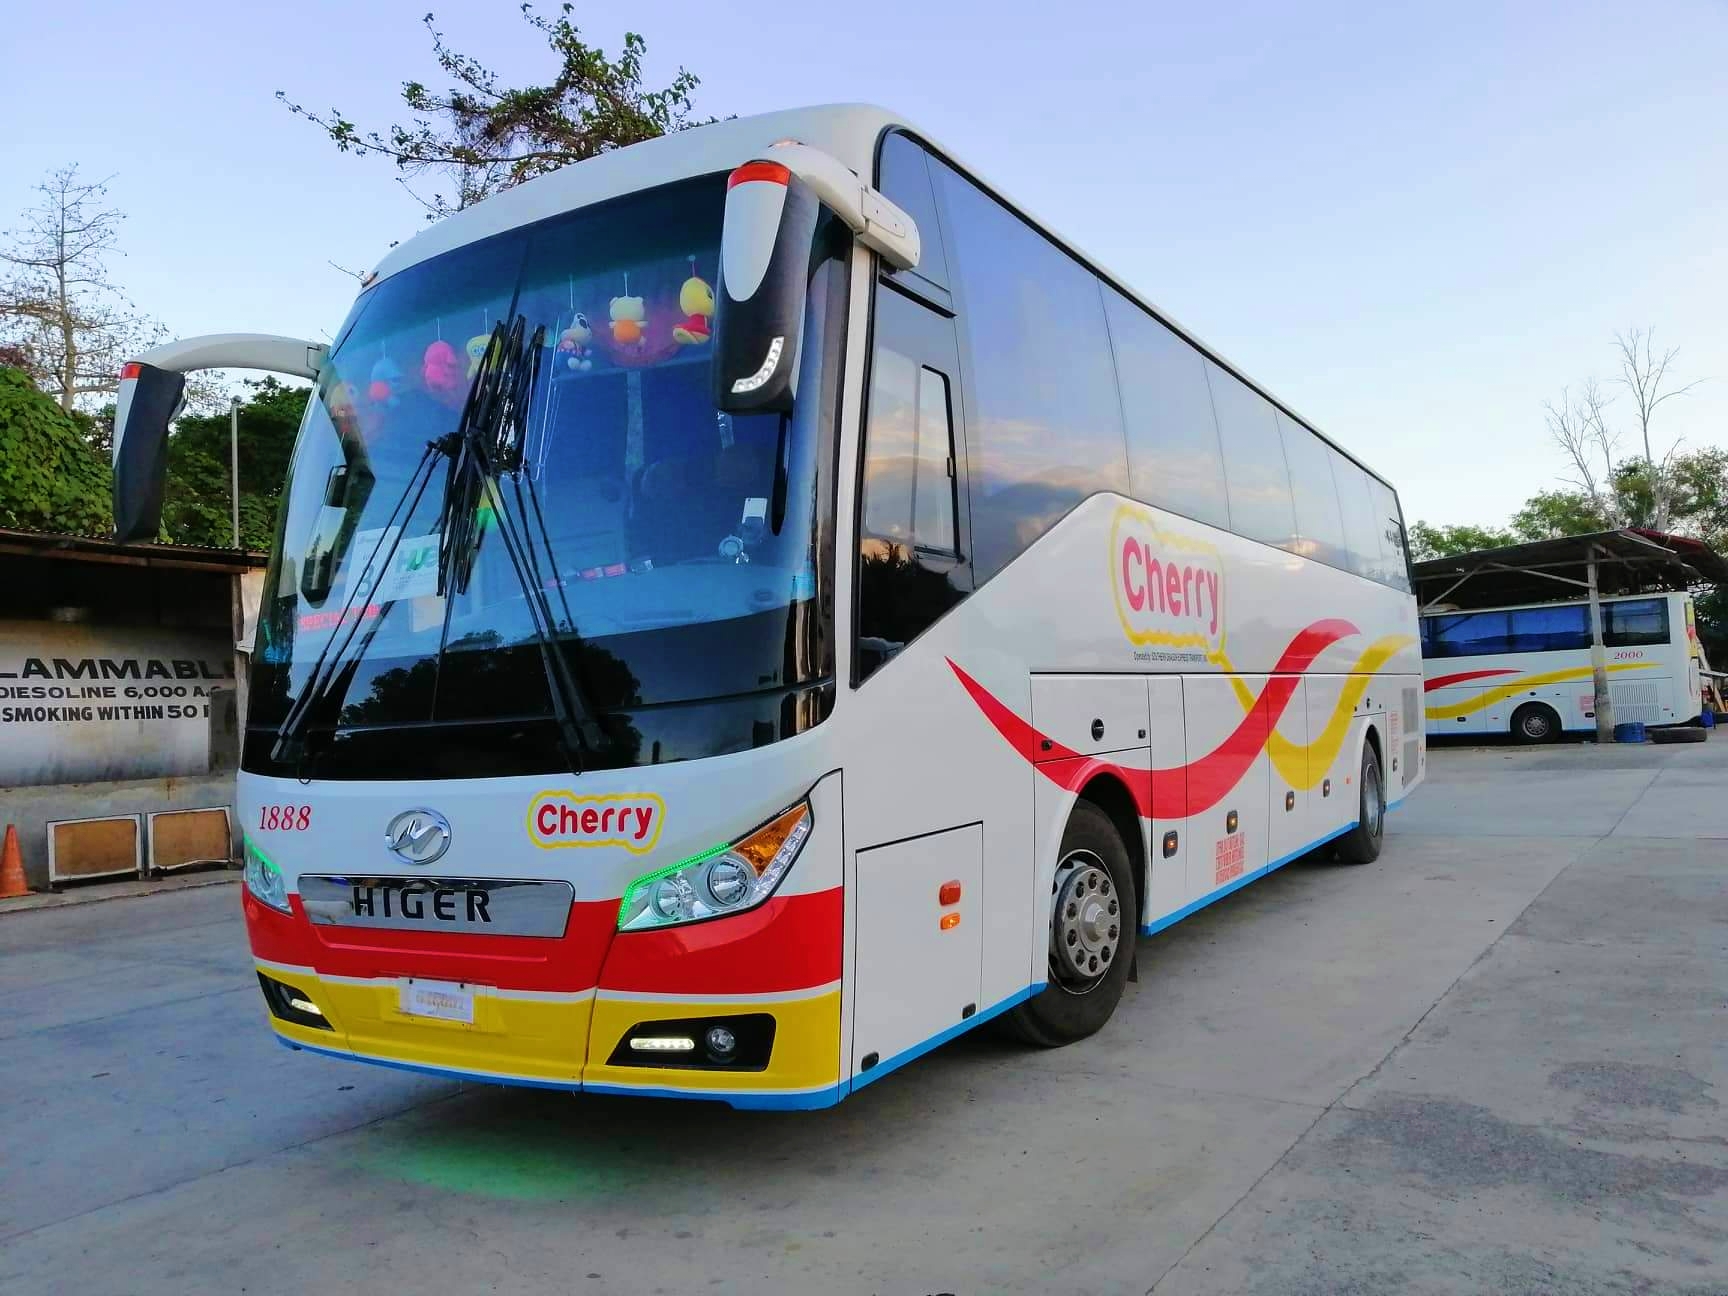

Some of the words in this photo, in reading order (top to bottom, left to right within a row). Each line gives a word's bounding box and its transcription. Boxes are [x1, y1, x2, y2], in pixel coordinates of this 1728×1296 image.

[1121, 536, 1219, 636] Cherry
[1613, 650, 1645, 660] 2000
[0, 686, 117, 699] DIESOLINE
[123, 685, 187, 700] 6,000
[2, 705, 93, 723] SMOKING
[97, 703, 164, 721] WITHIN
[167, 704, 198, 719] 50
[259, 805, 311, 831] 1888
[537, 803, 653, 840] Cherry
[352, 885, 492, 923] HIGER
